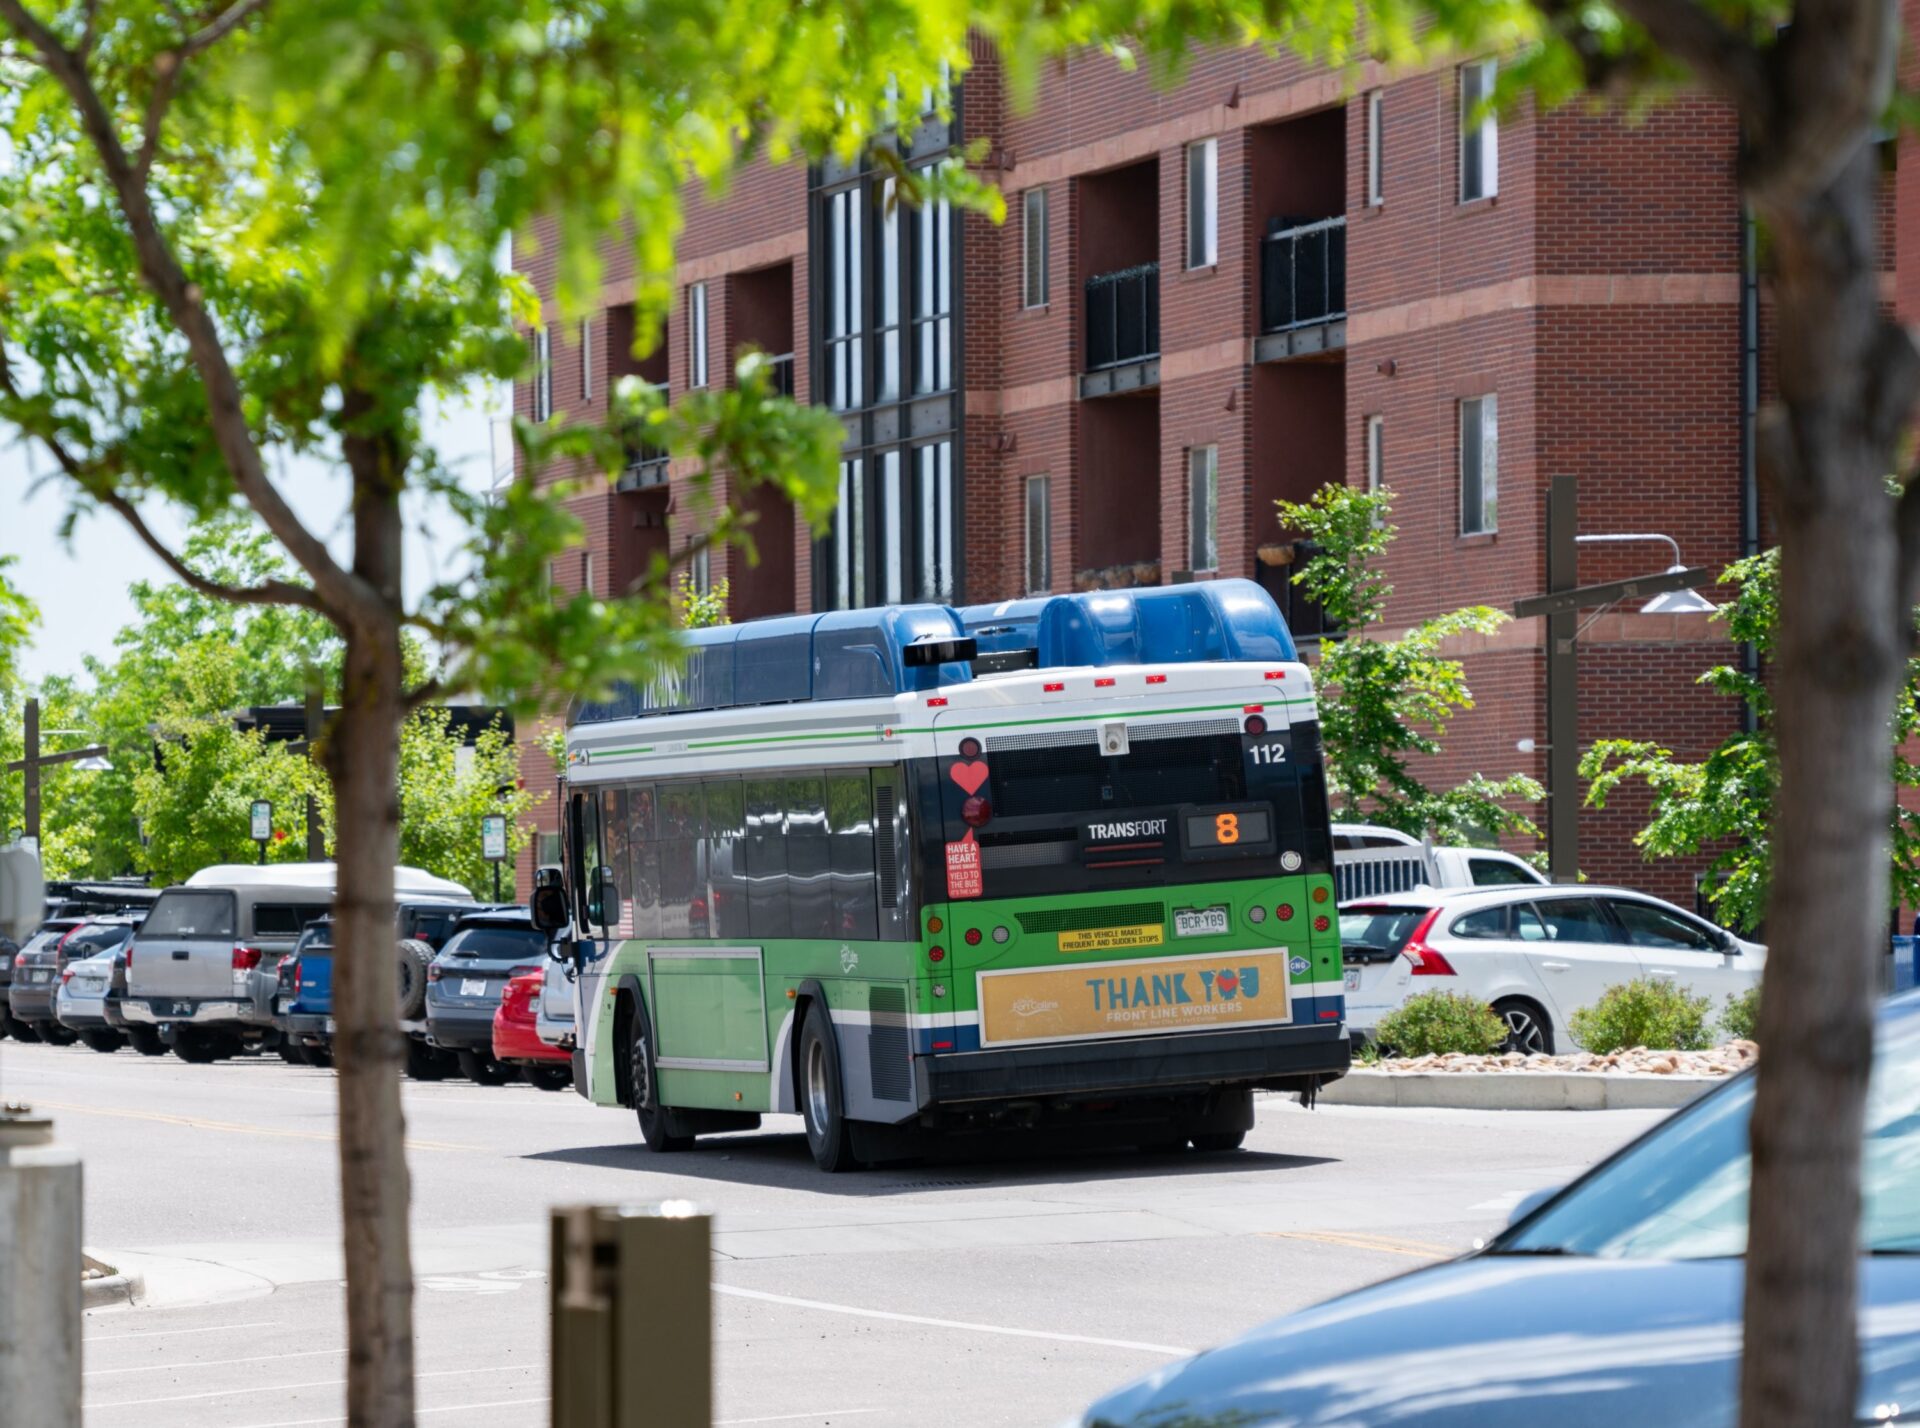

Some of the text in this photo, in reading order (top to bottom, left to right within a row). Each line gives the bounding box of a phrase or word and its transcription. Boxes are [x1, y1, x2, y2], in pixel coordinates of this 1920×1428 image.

[1249, 743, 1286, 765] 112
[1088, 818, 1168, 840] TRANSFORT
[1216, 813, 1239, 844] 8
[947, 843, 977, 854] HAVE A
[948, 853, 978, 865] HEART.
[950, 870, 979, 881] YIELD TO
[951, 880, 964, 889] THE
[1078, 928, 1143, 940] THIS VEHICLE MAKES
[1063, 935, 1160, 950] FREQUENT AND SUDDEN STOPS
[1290, 961, 1306, 971] CNG
[1086, 966, 1259, 1011] THANK YOU
[1106, 1002, 1243, 1023] FRONT LINE WORKERS
